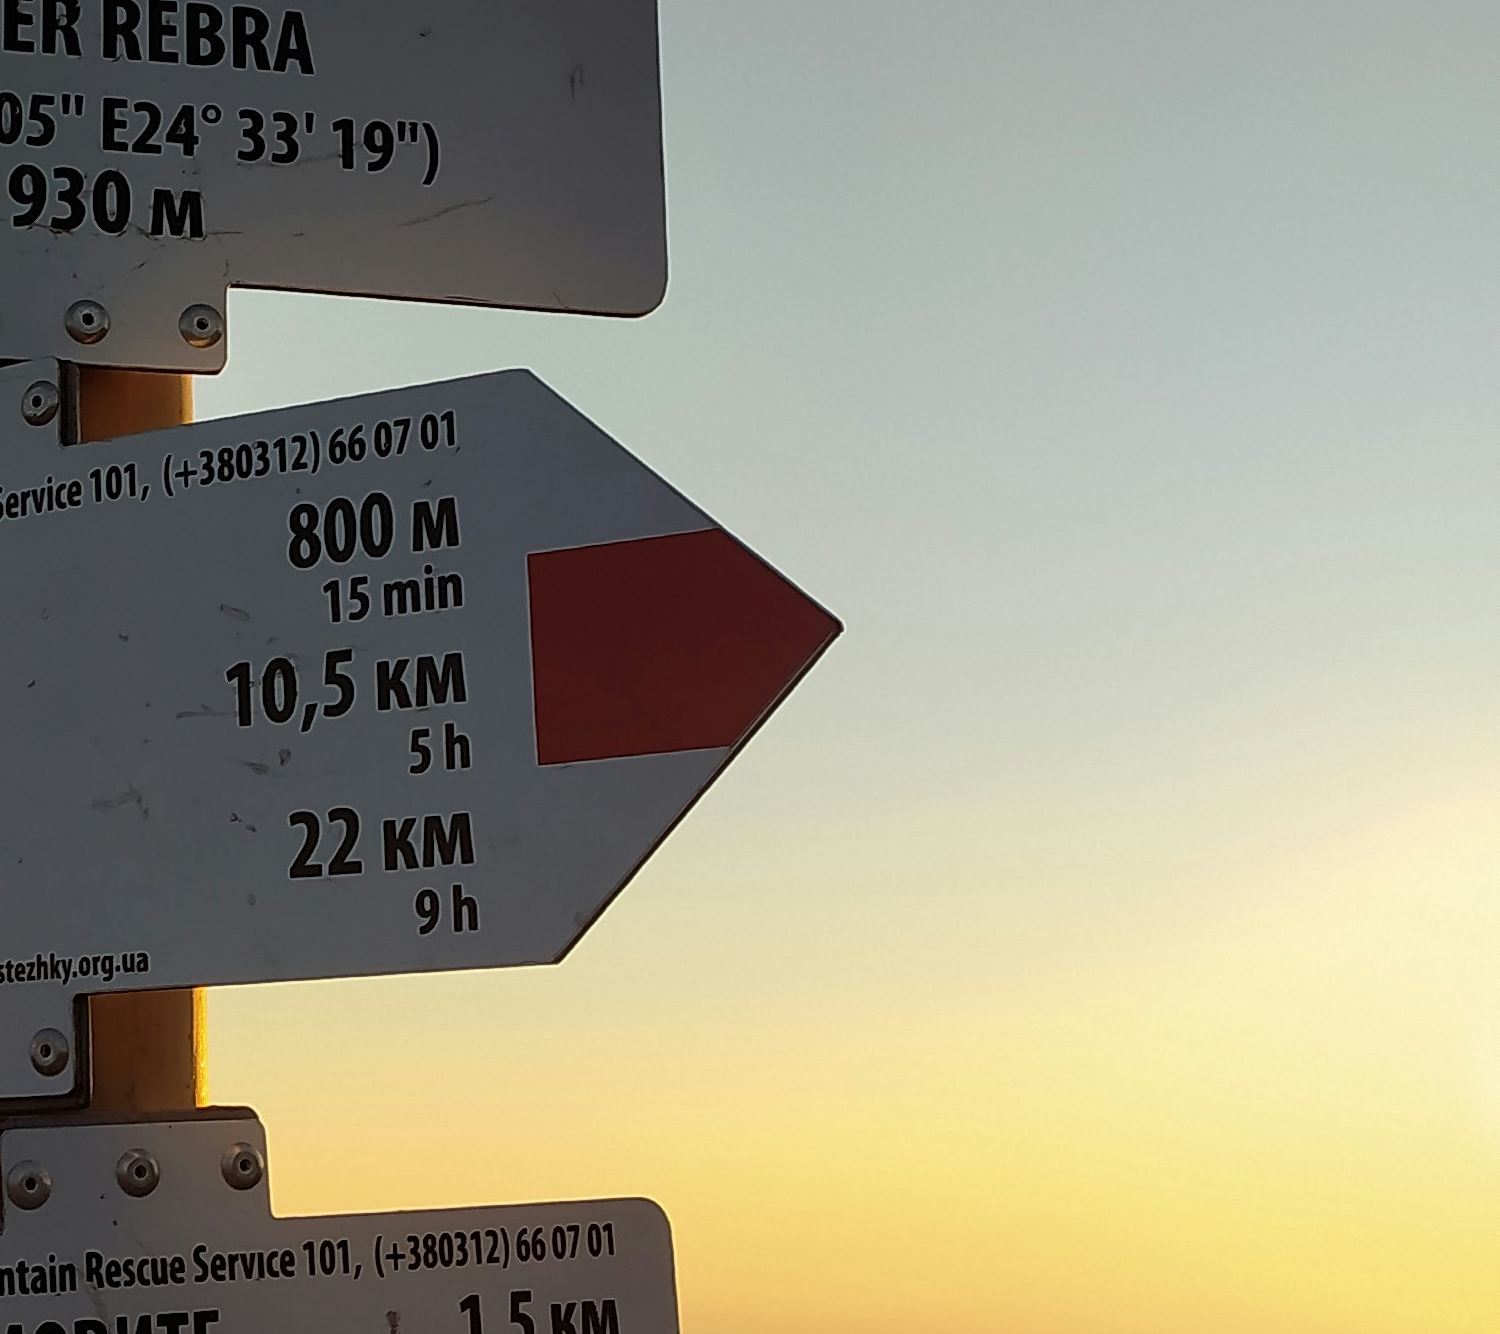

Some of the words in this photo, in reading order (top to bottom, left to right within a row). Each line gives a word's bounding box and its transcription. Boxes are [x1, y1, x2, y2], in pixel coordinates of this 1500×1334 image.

[102, 97, 222, 157] E24°
[149, 188, 204, 241] м
[89, 463, 150, 503] 101,
[163, 430, 320, 497] (+380312)
[328, 424, 367, 465] 66
[373, 418, 411, 458] 07
[420, 410, 455, 450] 01
[288, 492, 394, 569] 800
[412, 497, 460, 552] м
[322, 575, 370, 623] 15
[383, 564, 463, 616] min
[225, 648, 355, 733] 10,5
[376, 652, 467, 711] км
[409, 728, 431, 774] 5
[444, 722, 471, 770] h
[289, 807, 363, 879] 22
[383, 812, 475, 871] км
[415, 889, 440, 935] 9
[452, 884, 479, 933] h
[85, 1251, 186, 1289] Rescue
[192, 1244, 296, 1283] Service
[302, 1239, 362, 1280] 101,
[374, 1227, 510, 1279] (+380312)
[515, 1227, 546, 1262] 66
[551, 1224, 580, 1260] 07
[587, 1222, 615, 1258] 01
